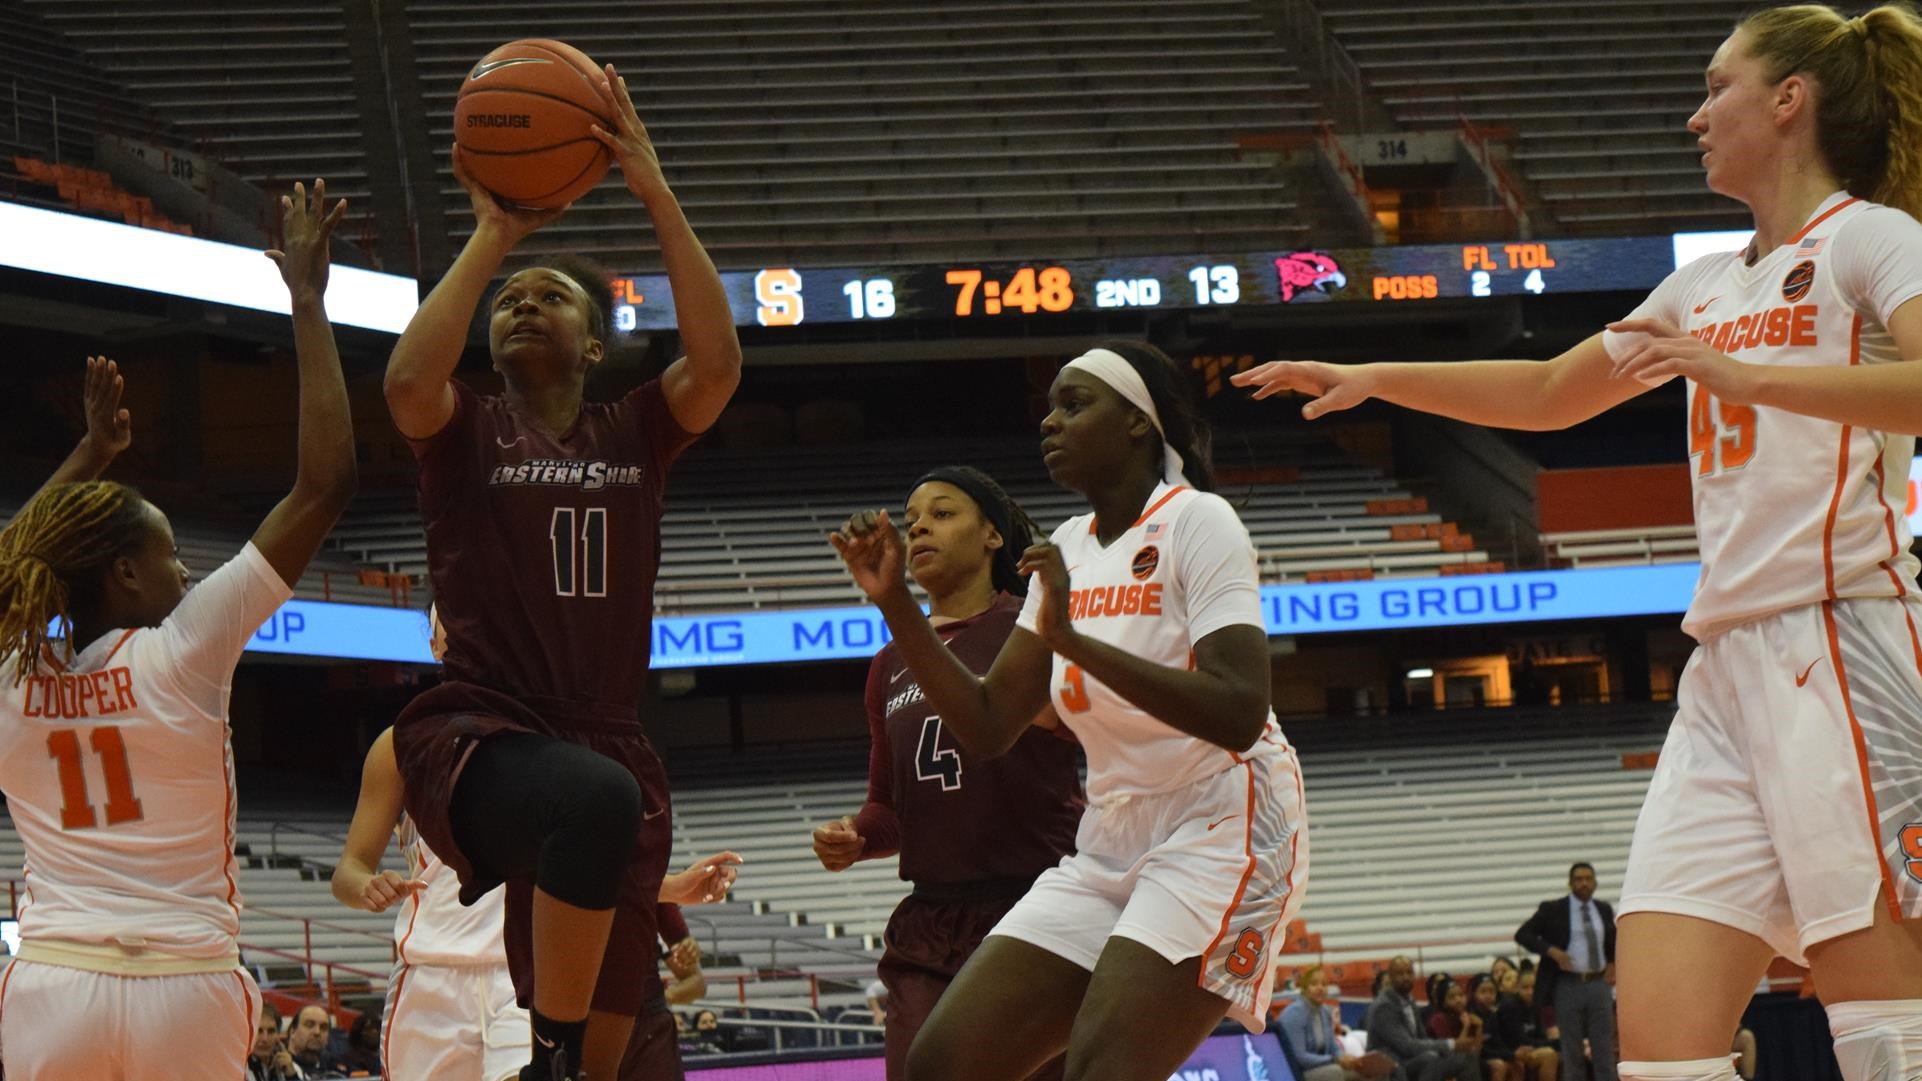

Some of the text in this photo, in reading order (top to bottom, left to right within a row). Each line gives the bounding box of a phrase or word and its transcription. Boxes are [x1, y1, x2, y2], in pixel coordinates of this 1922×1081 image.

[467, 114, 531, 128] SYRACUSE
[1378, 140, 1407, 159] 314
[1463, 244, 1555, 271] FL TOL
[843, 279, 896, 319] 16
[946, 267, 1074, 316] 7:48
[1096, 278, 1160, 308] 2ND
[1189, 265, 1240, 305] 13
[1373, 275, 1438, 300] POSS
[1471, 269, 1546, 297] 2 4
[1689, 382, 1758, 479] 45
[550, 507, 608, 597] 11
[1261, 593, 1359, 624] ING
[1381, 582, 1558, 618] GROUP
[23, 666, 138, 719] COOPER
[915, 715, 962, 792] 4
[47, 726, 144, 830] 11
